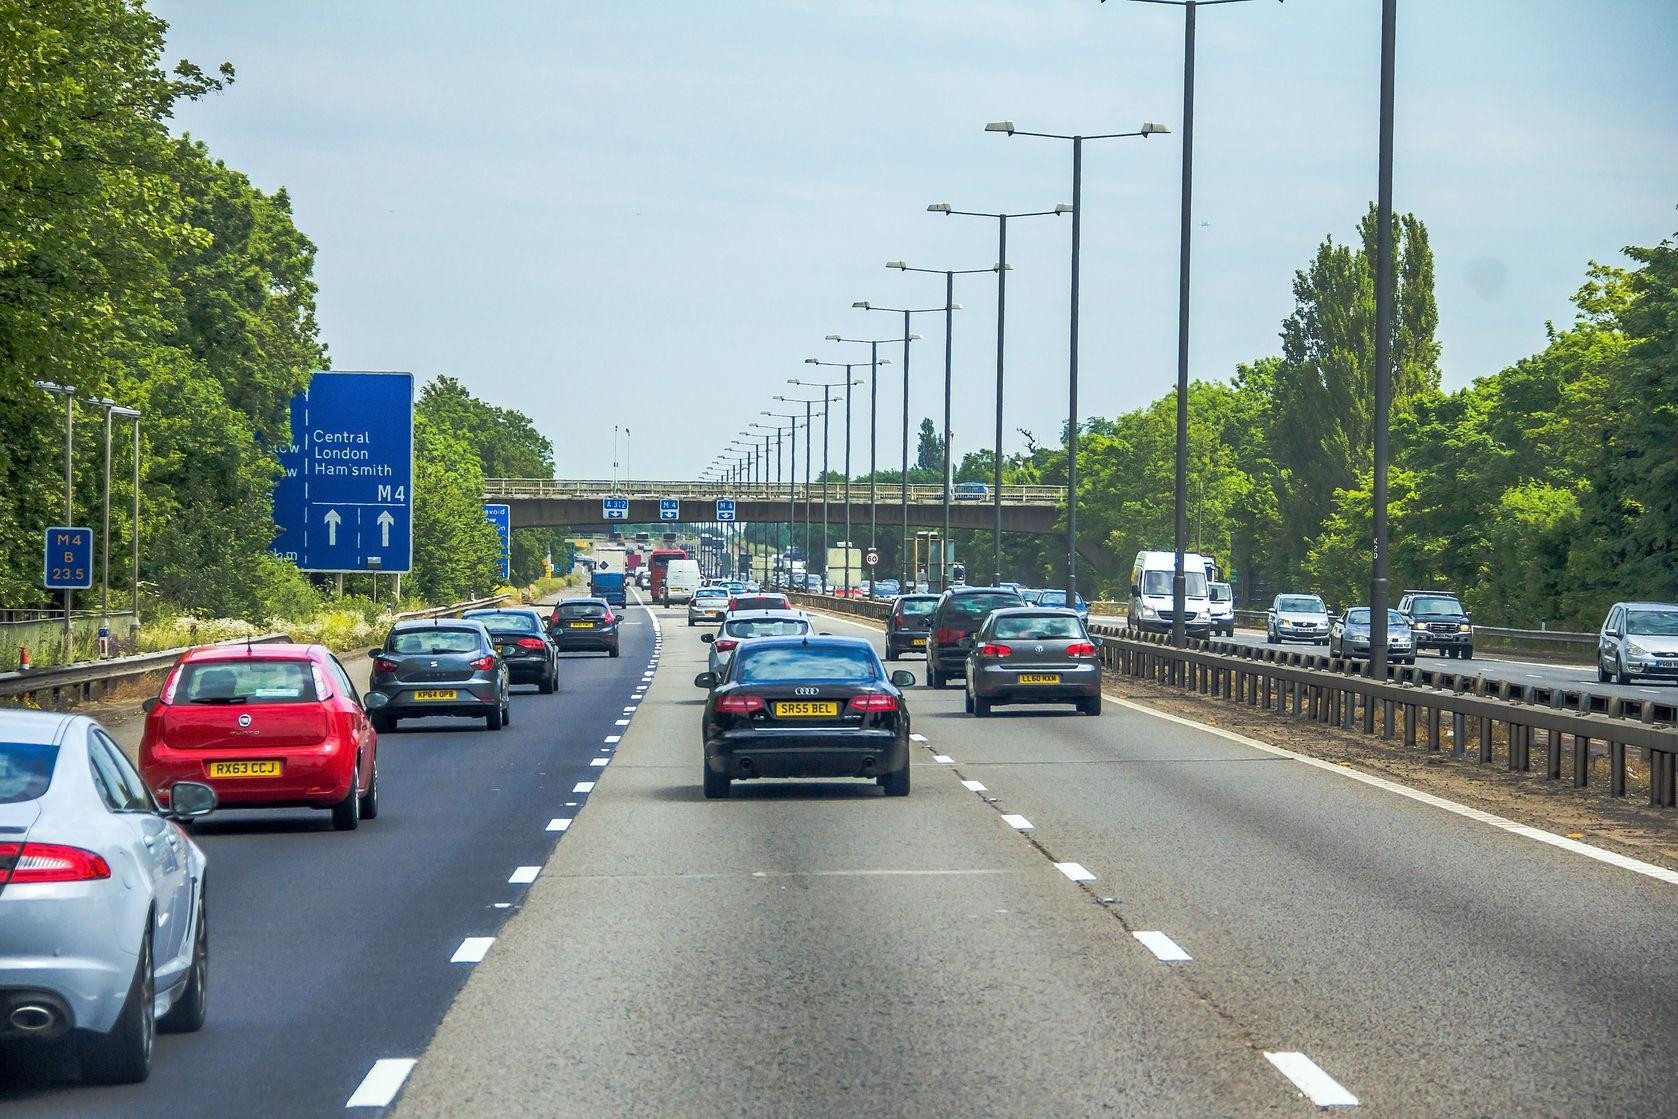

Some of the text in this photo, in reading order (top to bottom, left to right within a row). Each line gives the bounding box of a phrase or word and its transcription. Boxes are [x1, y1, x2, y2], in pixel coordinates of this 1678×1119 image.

[313, 430, 370, 443] Central
[314, 447, 369, 460] London
[314, 463, 392, 476] Ham'smith
[377, 484, 405, 502] M4
[57, 534, 82, 546] M4
[64, 552, 74, 563] B
[867, 555, 878, 563] 60
[52, 568, 84, 580] 23.5
[781, 703, 832, 714] SR55 BEL
[216, 762, 275, 775] RX63 CCJ
